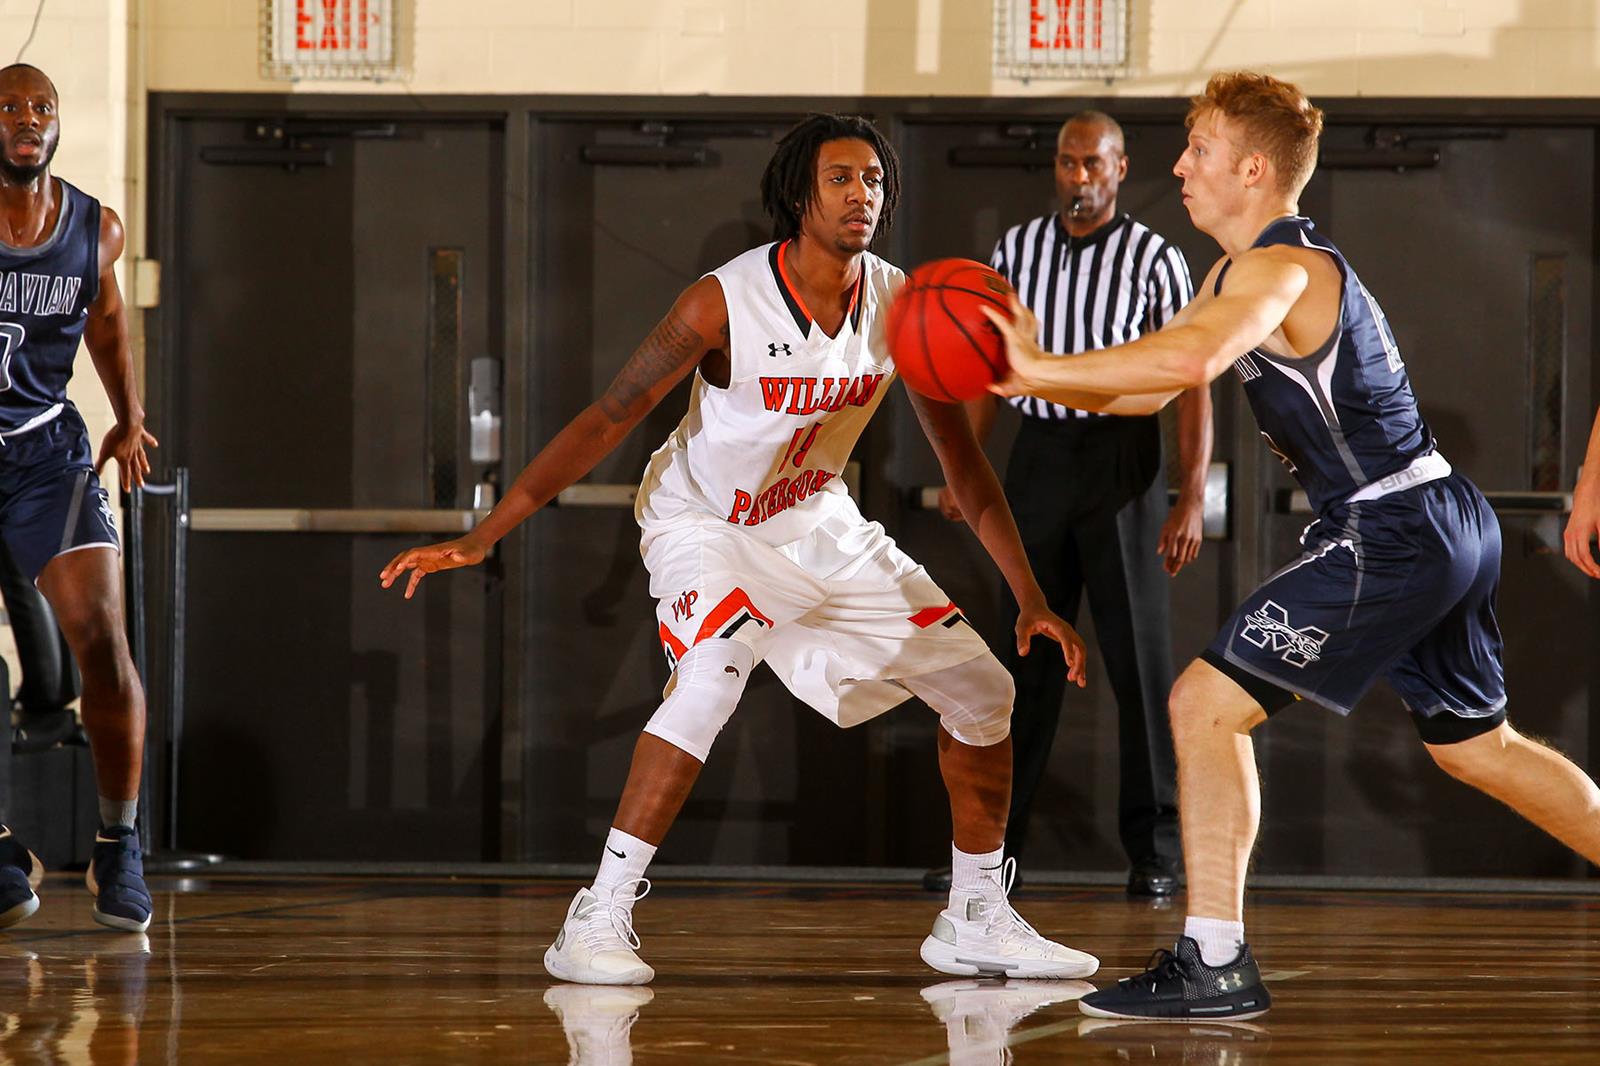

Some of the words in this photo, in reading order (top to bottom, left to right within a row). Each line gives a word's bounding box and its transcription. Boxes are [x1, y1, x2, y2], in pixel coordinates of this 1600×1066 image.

[0, 271, 82, 316] AVIAN
[759, 374, 884, 416] WILLIAM
[727, 469, 836, 526] PATERSON
